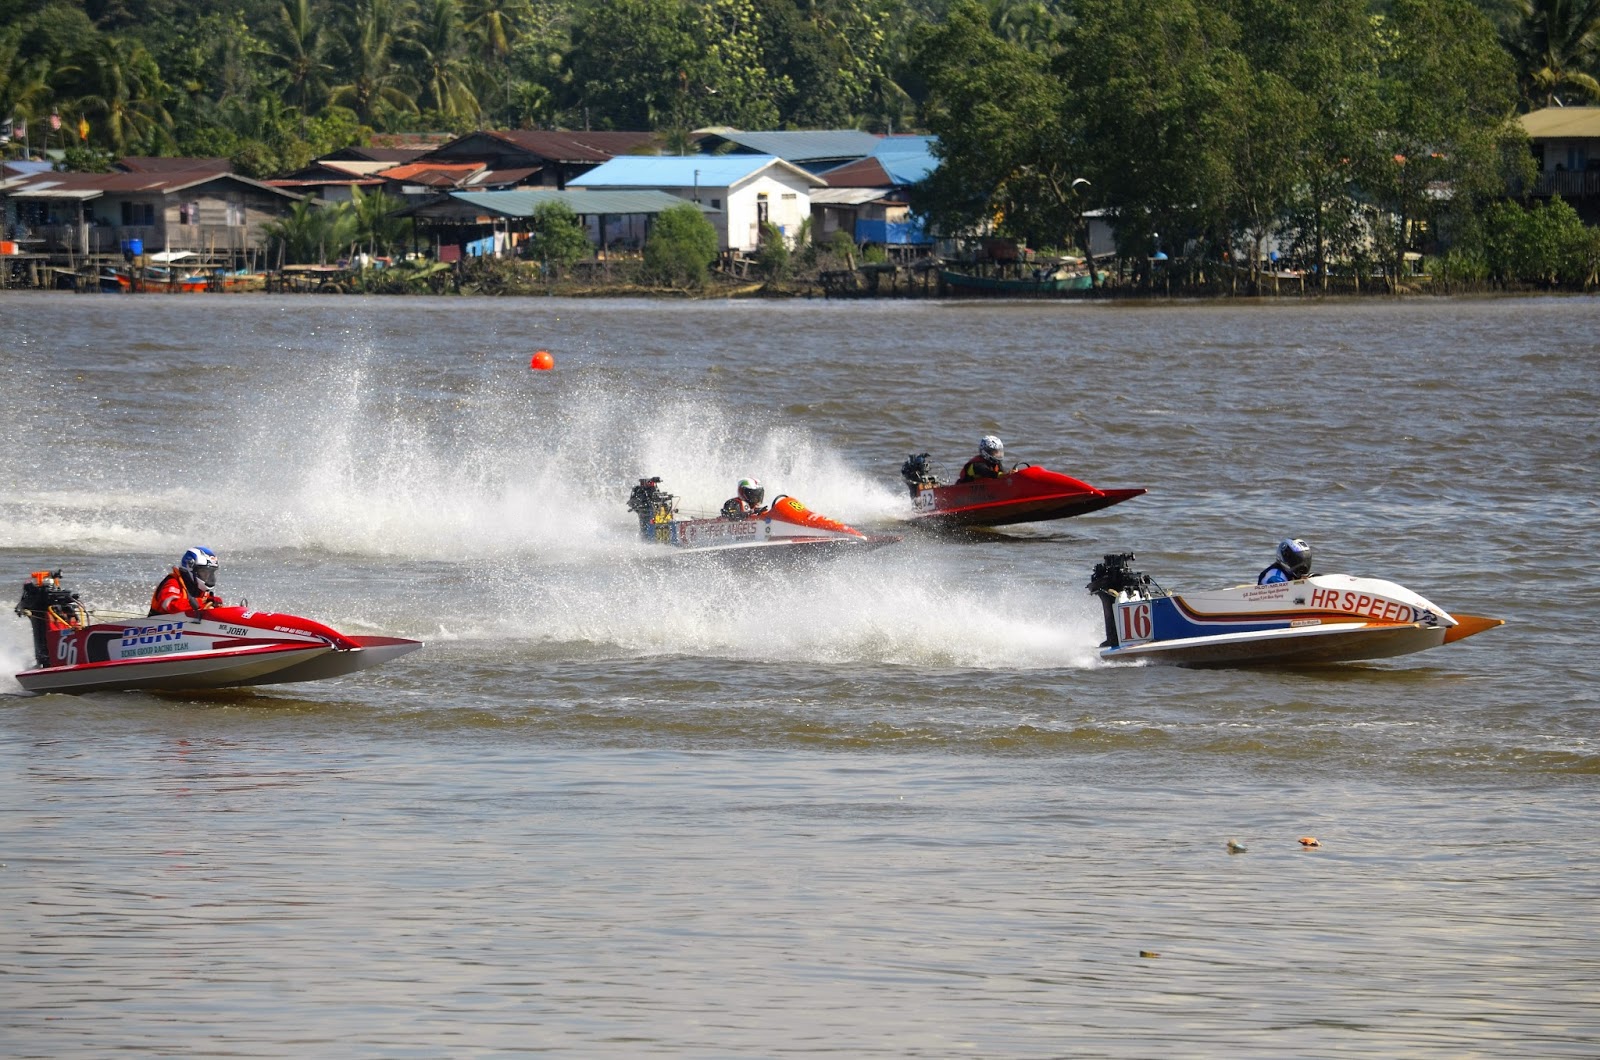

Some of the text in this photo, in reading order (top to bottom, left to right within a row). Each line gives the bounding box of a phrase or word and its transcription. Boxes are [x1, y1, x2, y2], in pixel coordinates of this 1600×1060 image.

[727, 522, 757, 535] ANGELS
[1310, 588, 1339, 609] HR
[1341, 592, 1411, 623] SPEED
[227, 627, 249, 636] JOHN
[1120, 604, 1151, 640] 16
[57, 635, 78, 665] 66
[137, 646, 153, 656] GROUP
[154, 644, 173, 654] RACING
[174, 642, 189, 651] TEAM
